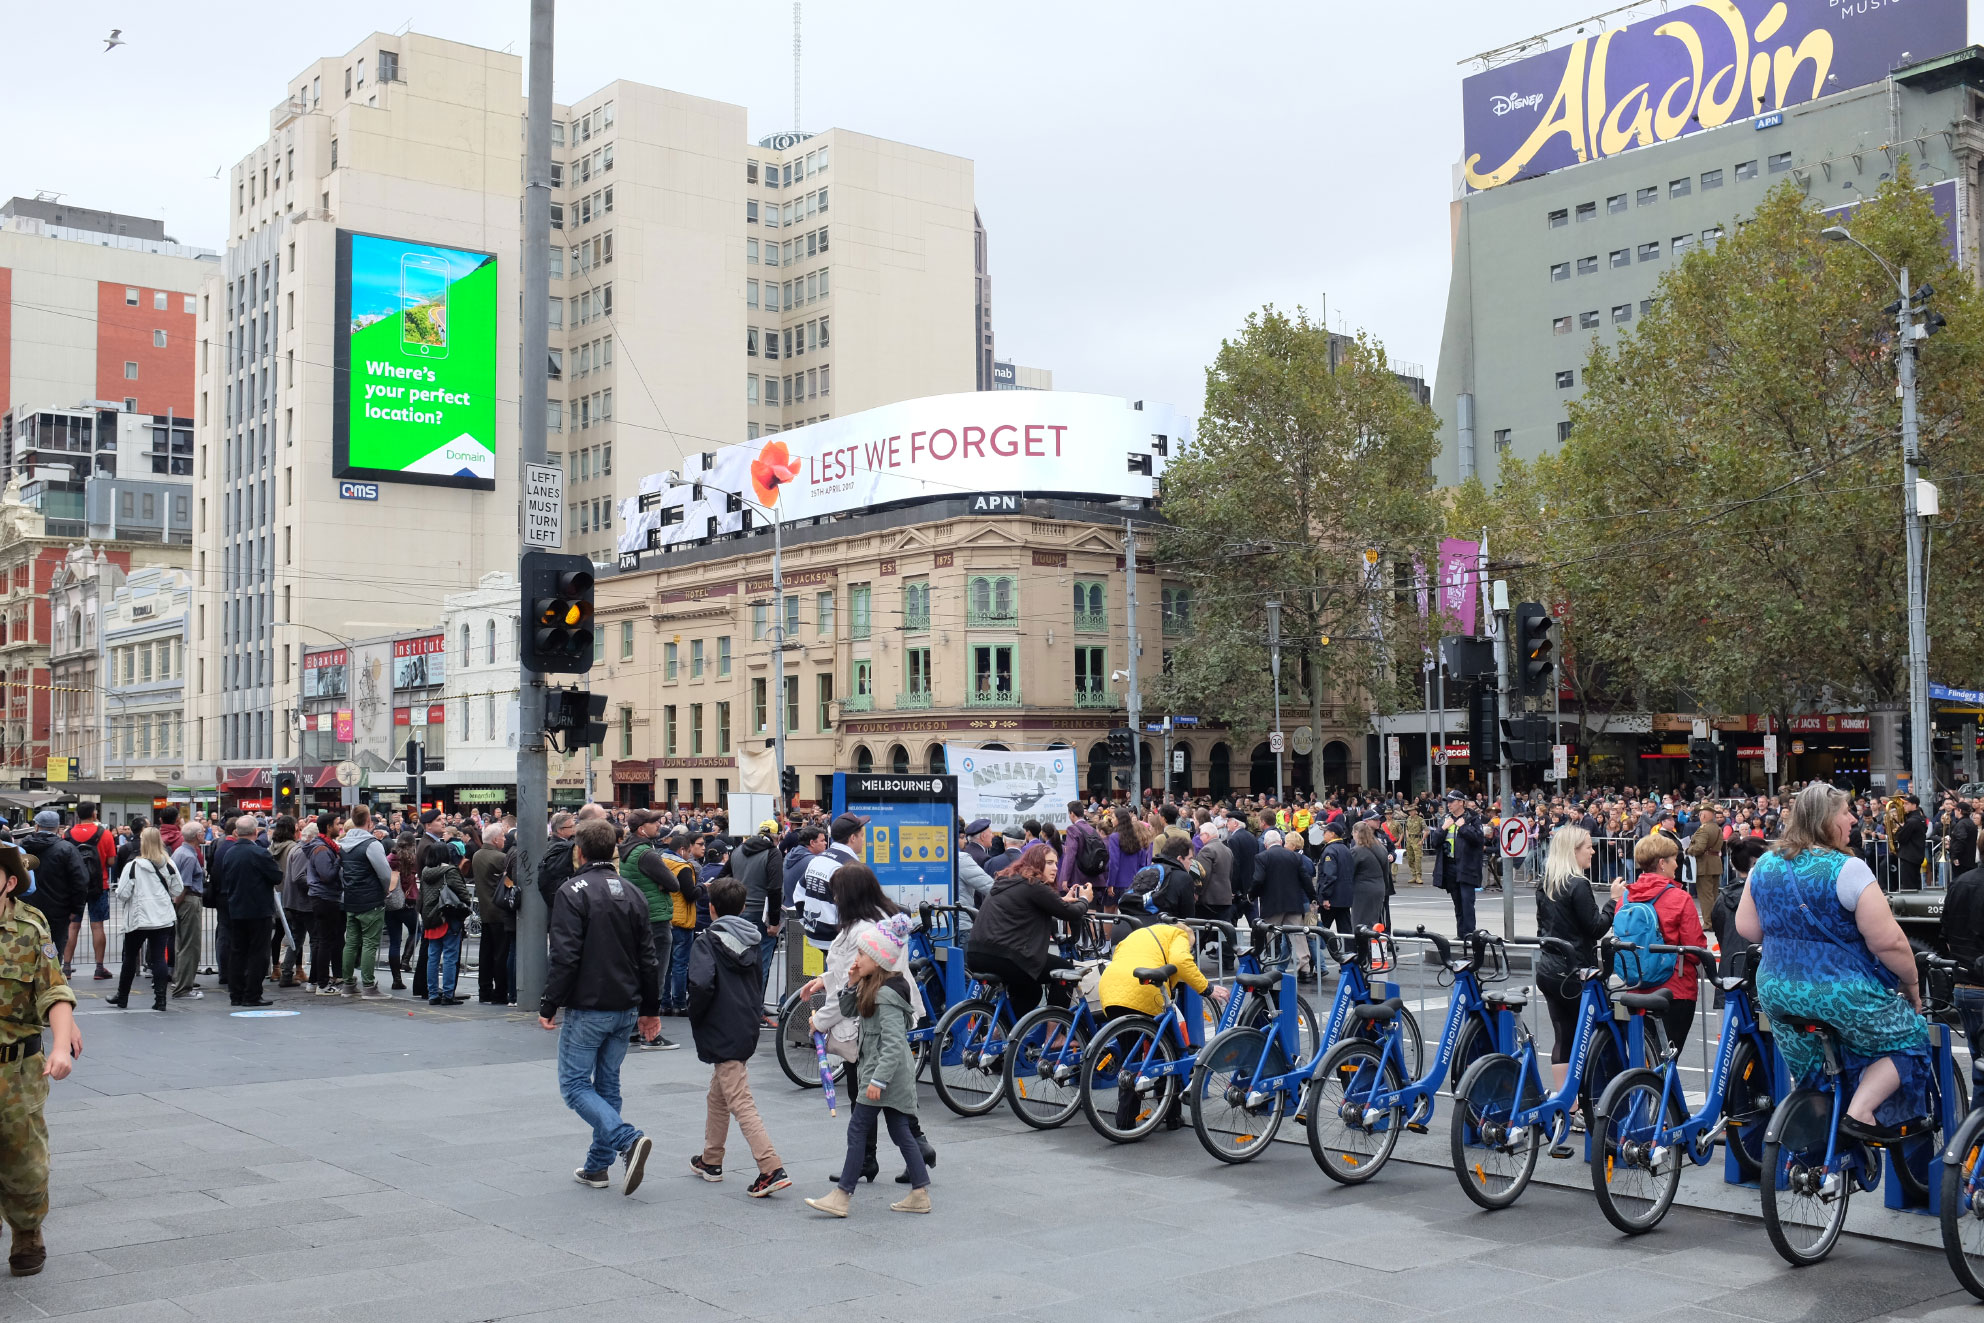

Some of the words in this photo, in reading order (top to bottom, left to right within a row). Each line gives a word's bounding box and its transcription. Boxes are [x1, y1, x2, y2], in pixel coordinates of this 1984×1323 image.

[1465, 0, 1834, 190] Aladdin
[1757, 115, 1779, 128] APN
[365, 359, 437, 382] Where's
[994, 367, 1013, 379] nab
[364, 383, 406, 399] your
[408, 387, 471, 406] perfect
[364, 402, 444, 425] location?
[445, 449, 486, 463] Domain
[810, 445, 859, 486] LEST
[864, 435, 901, 473] WE
[911, 424, 1068, 464] FORGET
[531, 471, 557, 485] LEFT
[341, 483, 377, 499] QMS
[527, 483, 560, 499] LANES
[825, 484, 842, 494] APRIL
[528, 499, 559, 513] MUST
[974, 495, 1016, 510] APN
[529, 514, 558, 528] TURN
[530, 528, 556, 542] LEFT
[619, 555, 637, 569] APN
[935, 553, 953, 567] 1875
[1033, 552, 1065, 565] YOUNG
[794, 571, 833, 584] JACKSON
[684, 588, 709, 600] HOTEL
[394, 638, 446, 657] institute
[313, 653, 344, 668] baxter
[1947, 689, 1977, 699] Flinders
[856, 723, 890, 733] YOUNG
[900, 721, 948, 731] JACKSON
[1052, 719, 1109, 729] PRINCE'S
[1841, 718, 1866, 729] HUNGRY
[1272, 738, 1282, 746] 30
[1444, 748, 1471, 757] acca's
[662, 759, 686, 767] YOUNG
[693, 758, 729, 767] JACKSON
[861, 780, 931, 792] MELBOURNE
[1440, 1003, 1464, 1065] MELBOURNE
[1573, 1014, 1593, 1080] MELBOURNE
[1716, 1027, 1736, 1097] MELBOURNE
